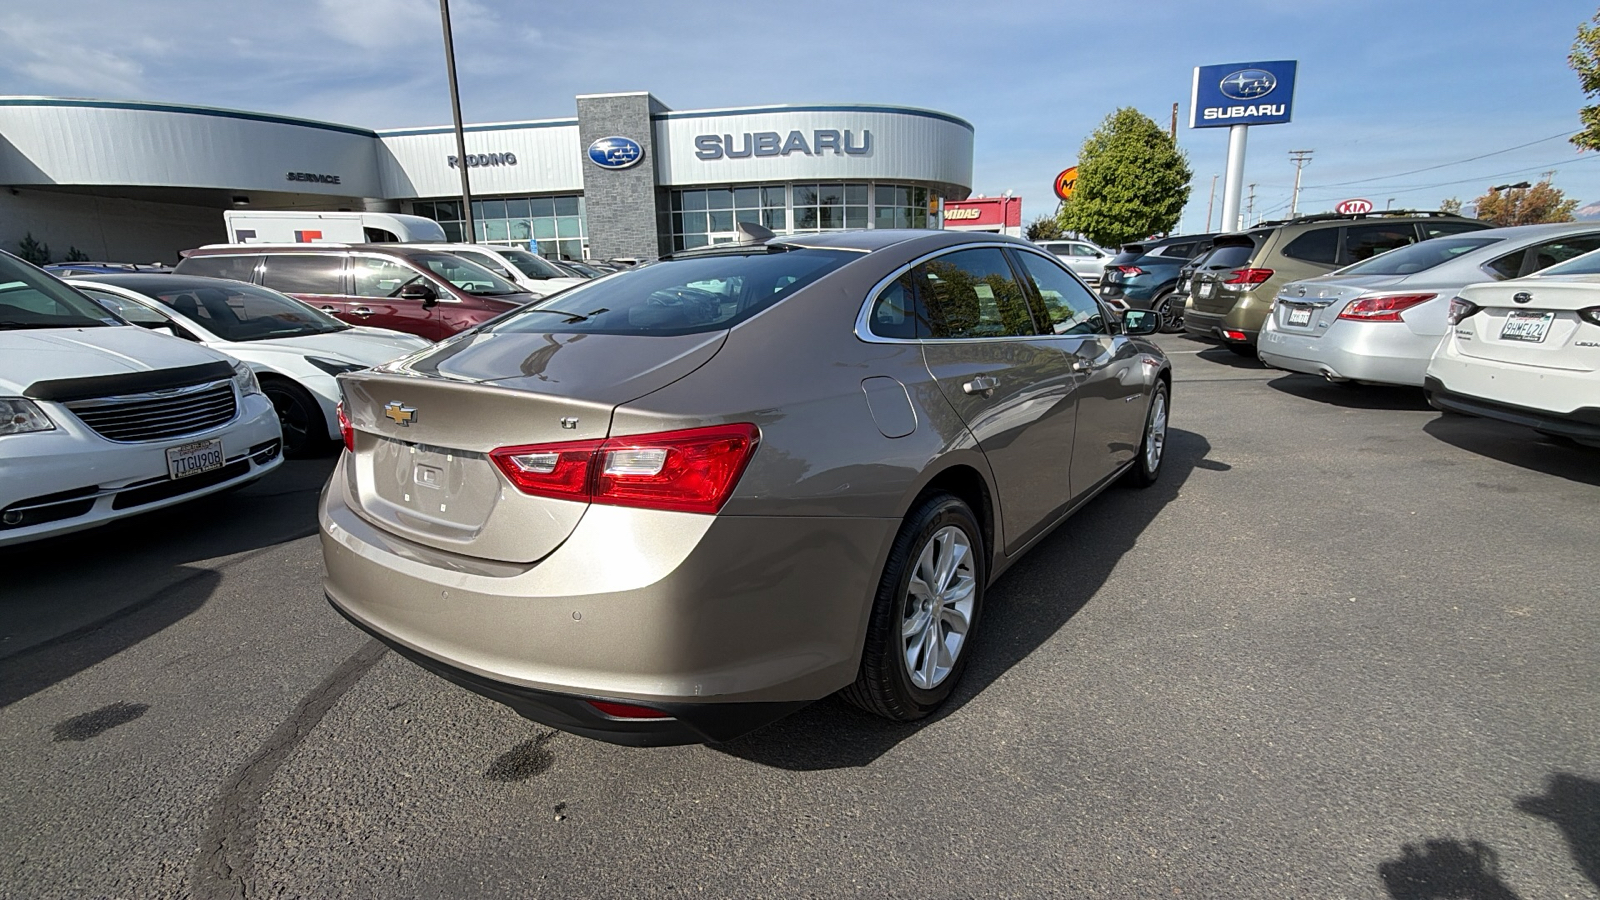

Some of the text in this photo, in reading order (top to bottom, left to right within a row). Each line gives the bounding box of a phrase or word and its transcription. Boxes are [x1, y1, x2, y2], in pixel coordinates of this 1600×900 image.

[1203, 104, 1286, 120] SUBARU
[694, 129, 872, 160] SUBARU
[447, 152, 517, 169] RDDING
[286, 171, 341, 185] SERVICE
[1343, 202, 1367, 214] KIA
[1506, 322, 1545, 336] 9HMF424
[560, 416, 579, 430] LT
[172, 450, 221, 473] 7TGU908
